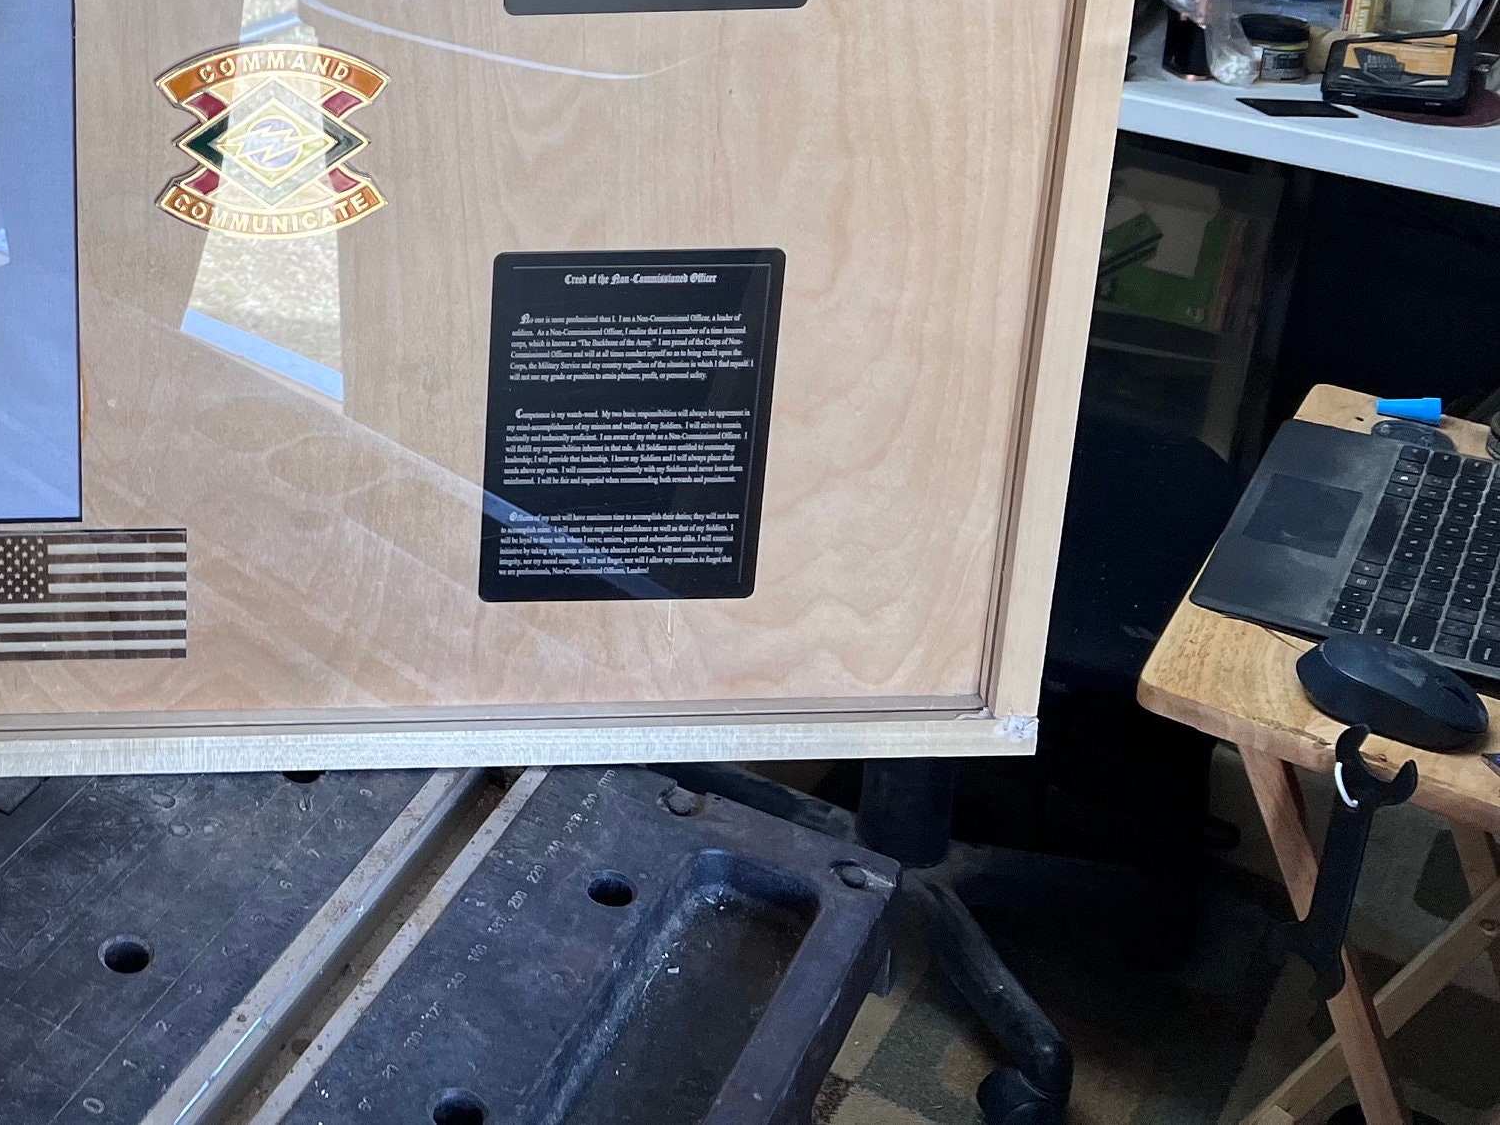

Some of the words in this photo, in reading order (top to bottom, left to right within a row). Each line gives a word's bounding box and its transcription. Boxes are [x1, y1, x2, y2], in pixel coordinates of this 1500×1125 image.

[198, 50, 351, 83] COMMAND
[173, 192, 369, 234] COMMUNICATE
[564, 273, 588, 285] Creed
[588, 273, 597, 285] of
[598, 273, 610, 286] the
